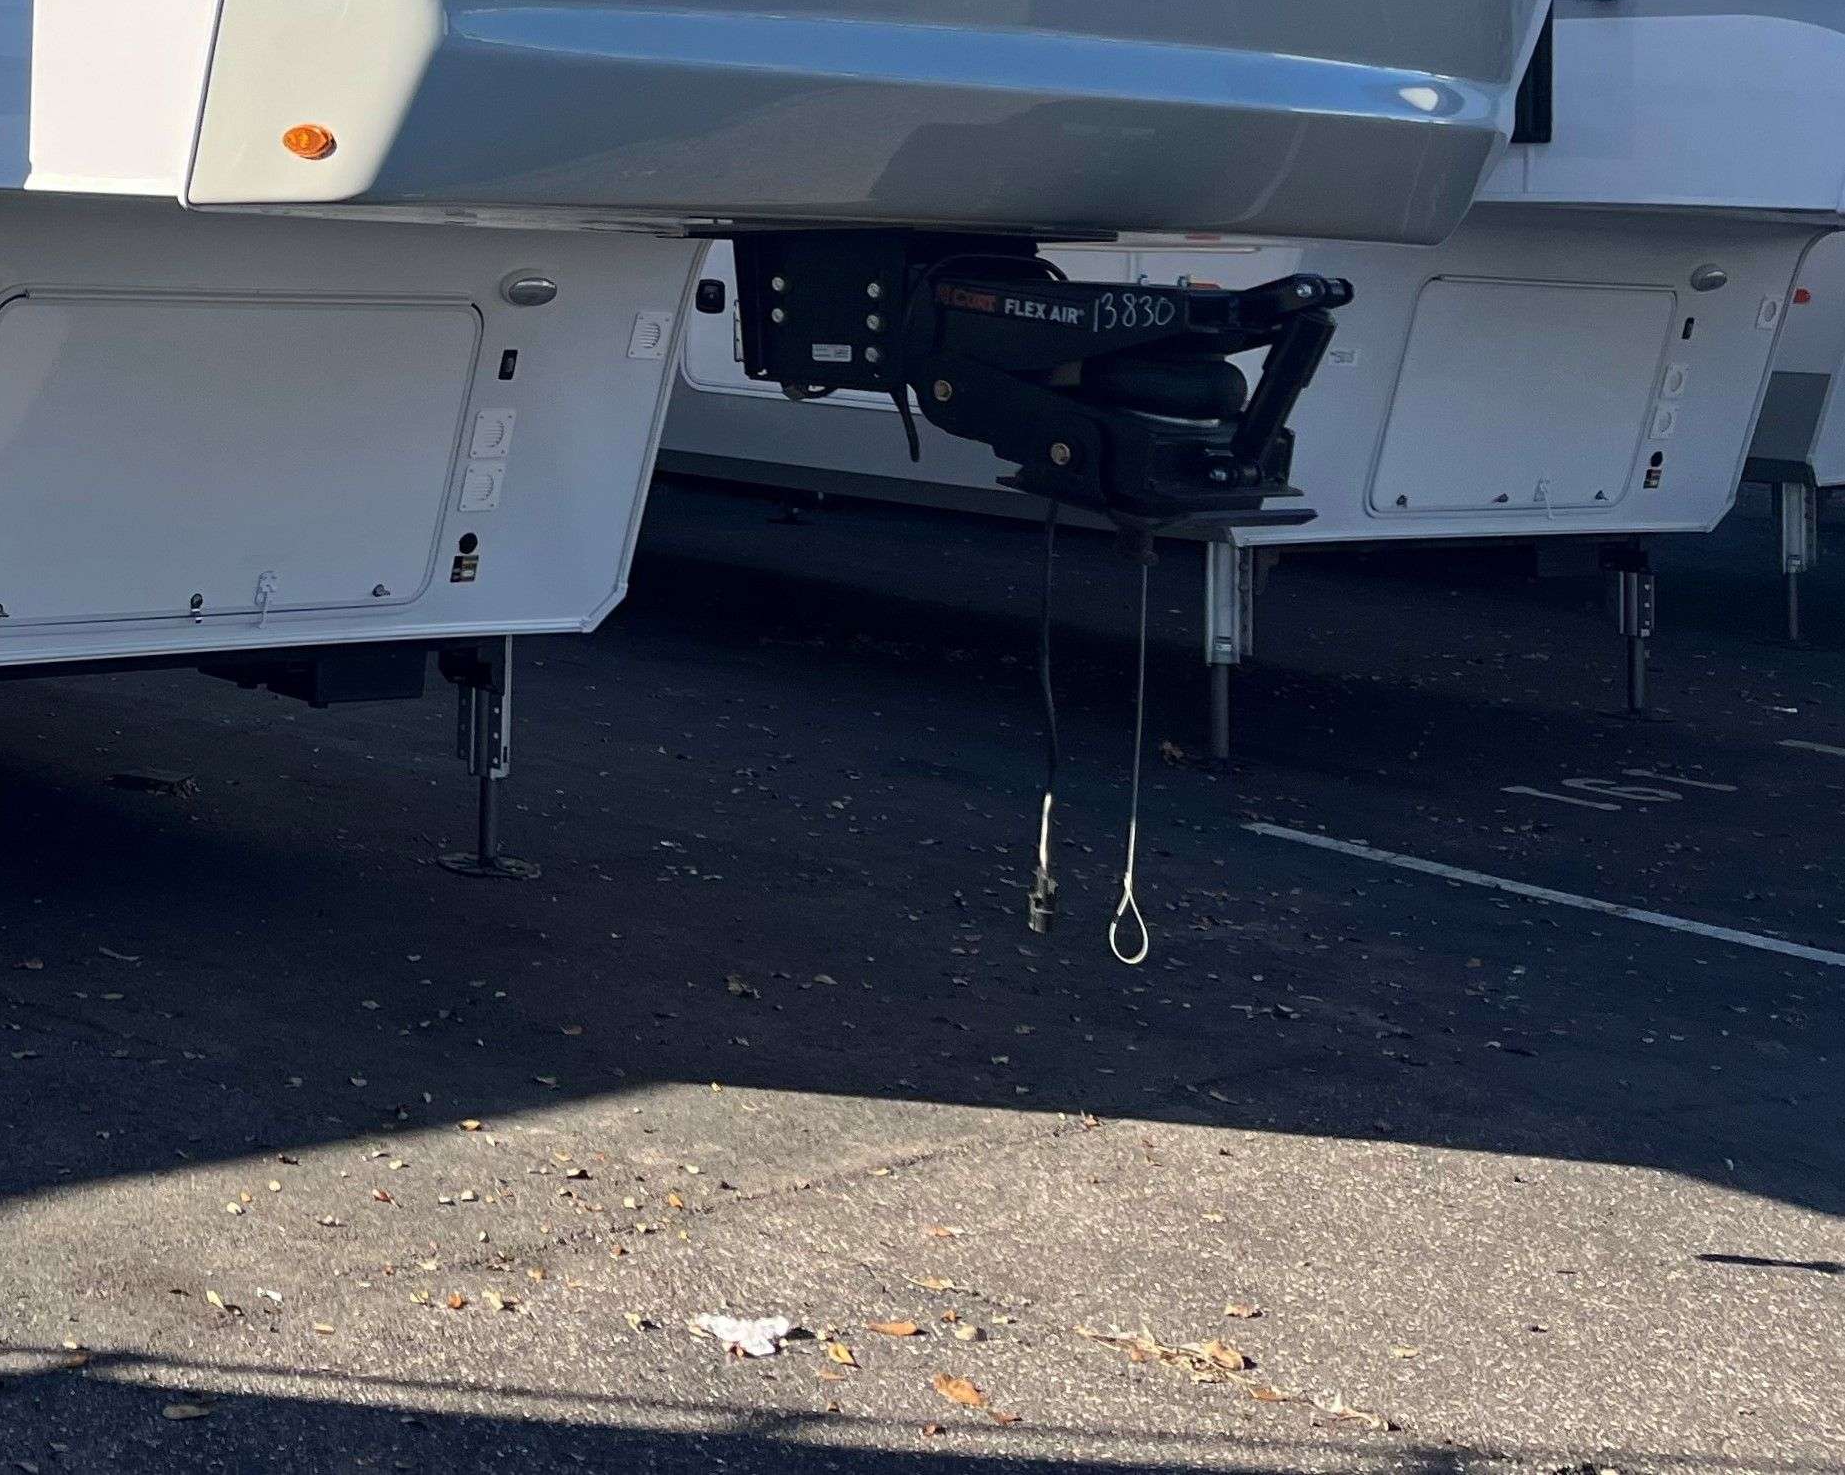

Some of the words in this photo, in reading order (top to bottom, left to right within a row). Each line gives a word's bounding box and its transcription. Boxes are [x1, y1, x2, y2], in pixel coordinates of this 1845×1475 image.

[1005, 298, 1046, 320] FLEX
[1049, 305, 1078, 324] AIR
[1093, 292, 1175, 332] 13830
